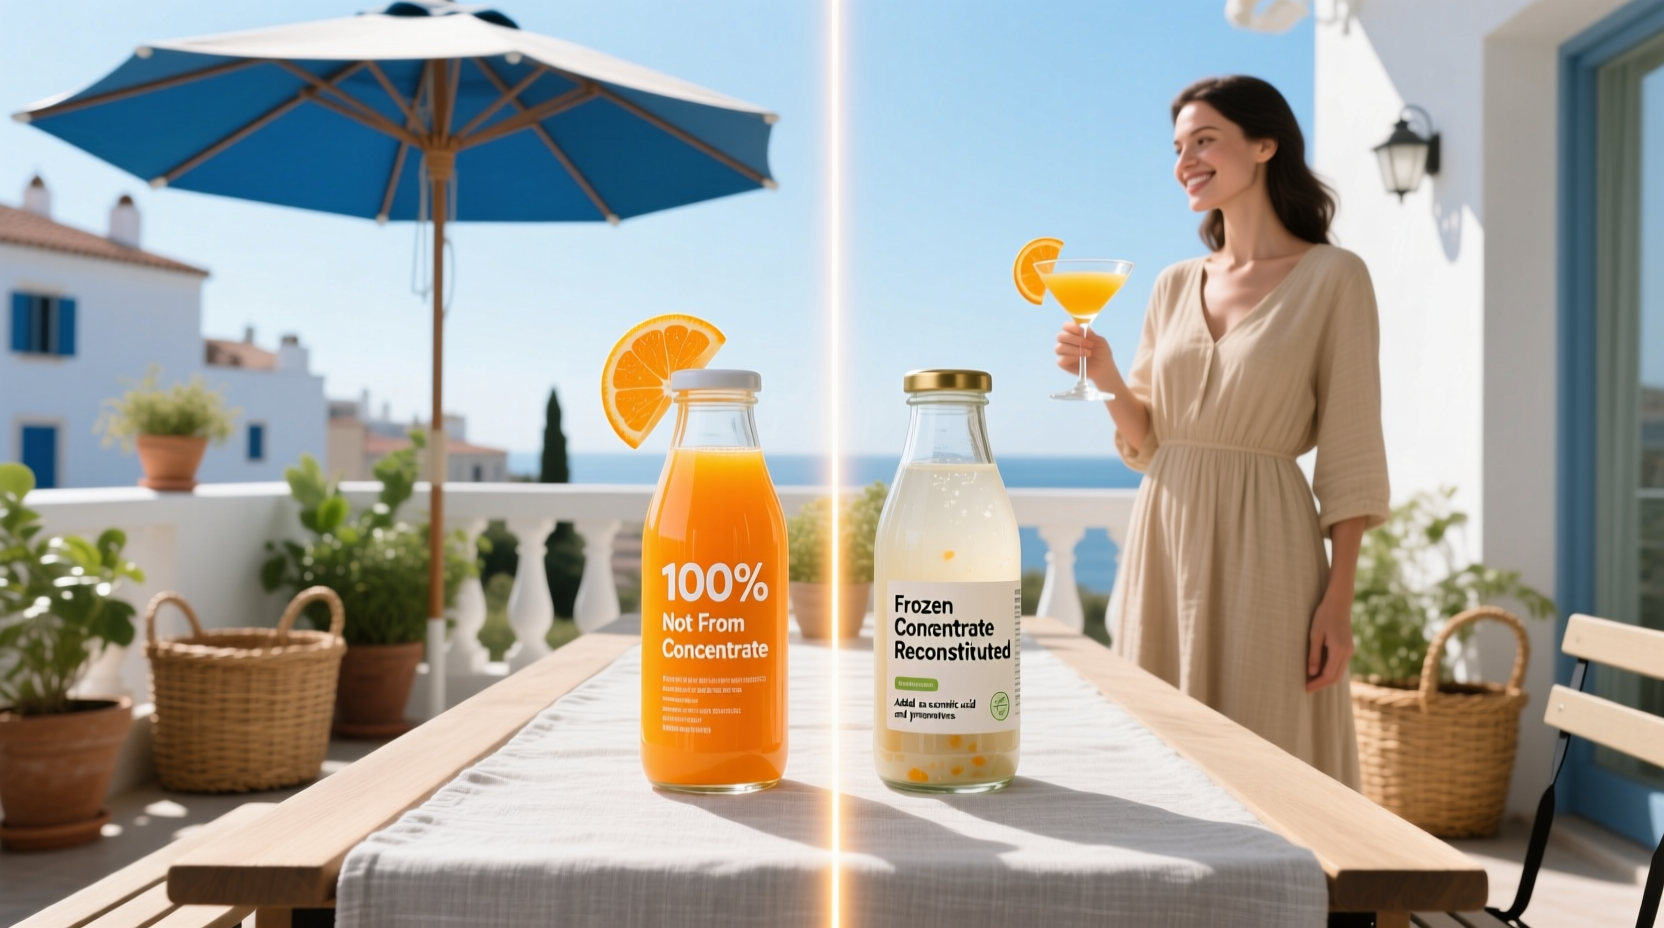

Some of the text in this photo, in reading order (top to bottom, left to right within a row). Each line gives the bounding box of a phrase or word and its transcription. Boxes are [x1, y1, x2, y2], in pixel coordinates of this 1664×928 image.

[661, 562, 768, 603] 100%
[894, 594, 953, 614] Frozen
[662, 612, 745, 633] Not From
[662, 638, 769, 659] Concentrate
[894, 640, 1011, 661] Reconstituted
